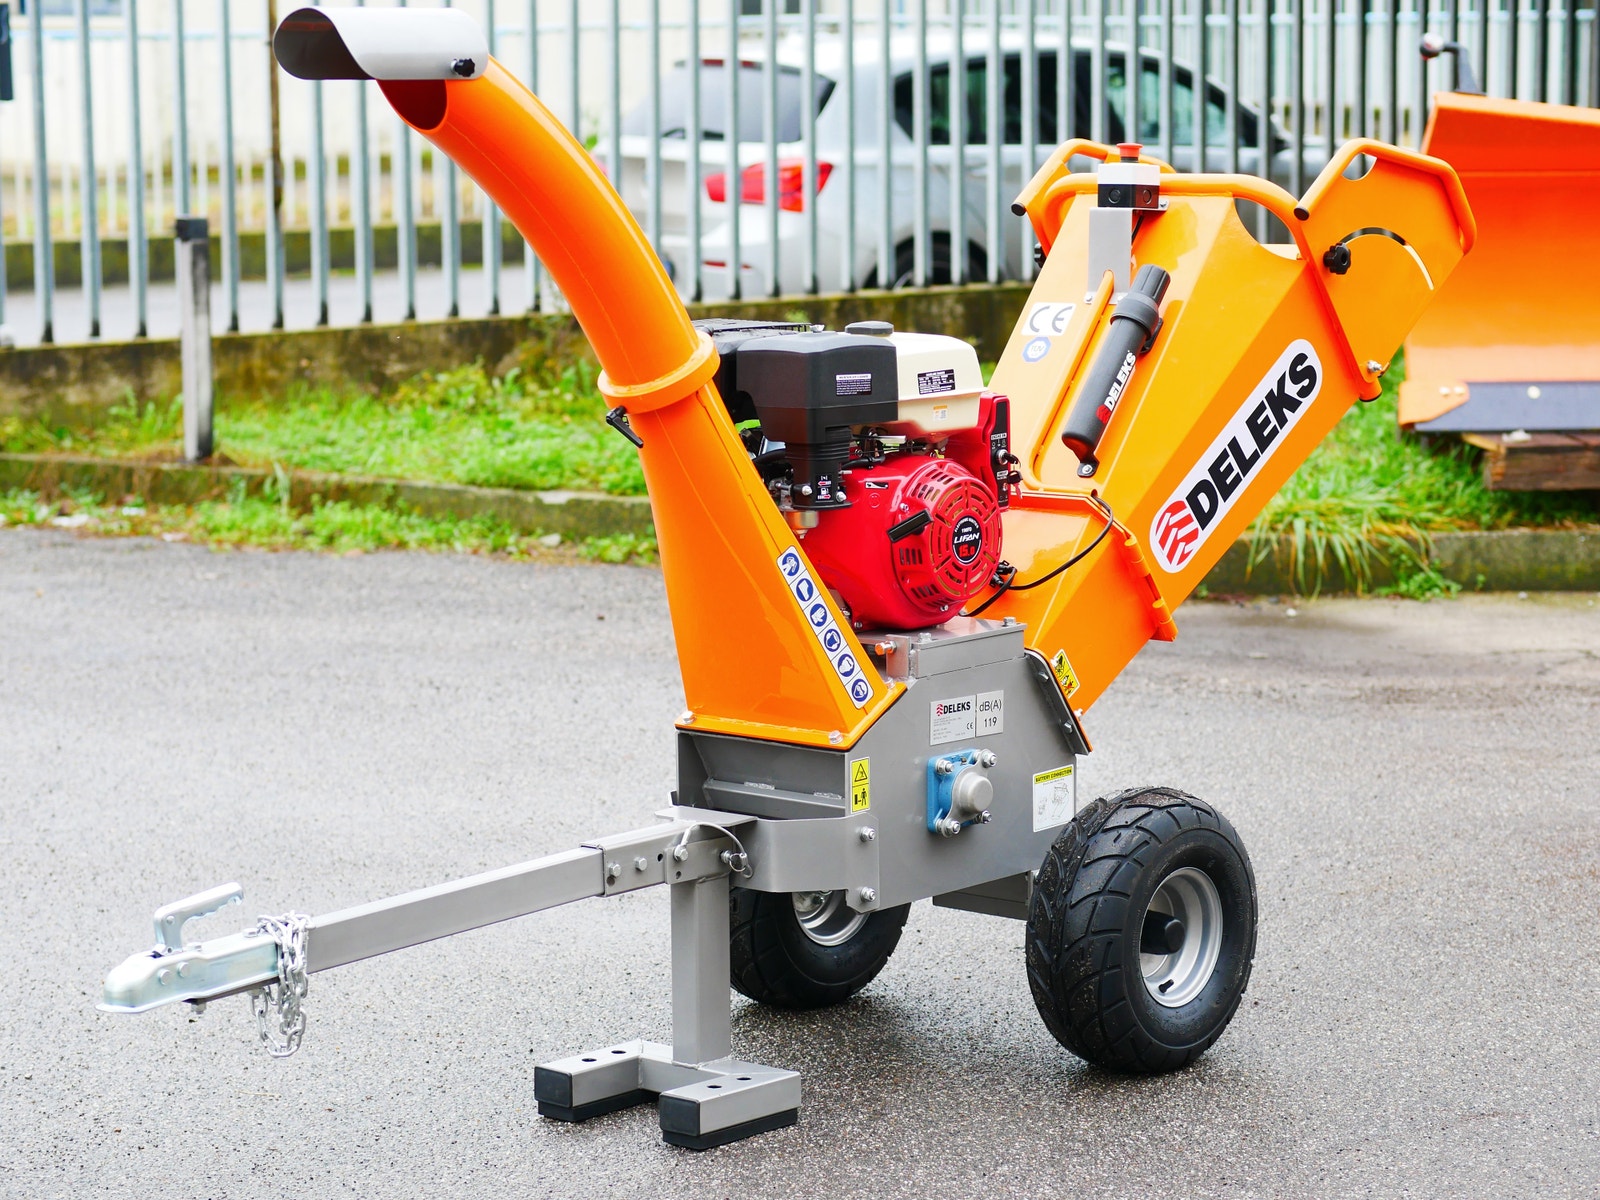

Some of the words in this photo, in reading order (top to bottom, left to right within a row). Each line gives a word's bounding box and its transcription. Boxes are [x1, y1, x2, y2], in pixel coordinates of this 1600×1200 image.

[1104, 352, 1136, 411] DELEKS
[1185, 353, 1317, 531] DELEKS
[954, 532, 980, 544] LIFAN
[943, 701, 971, 714] DELEKS
[979, 699, 1002, 712] dB(A)
[984, 717, 998, 728] 119
